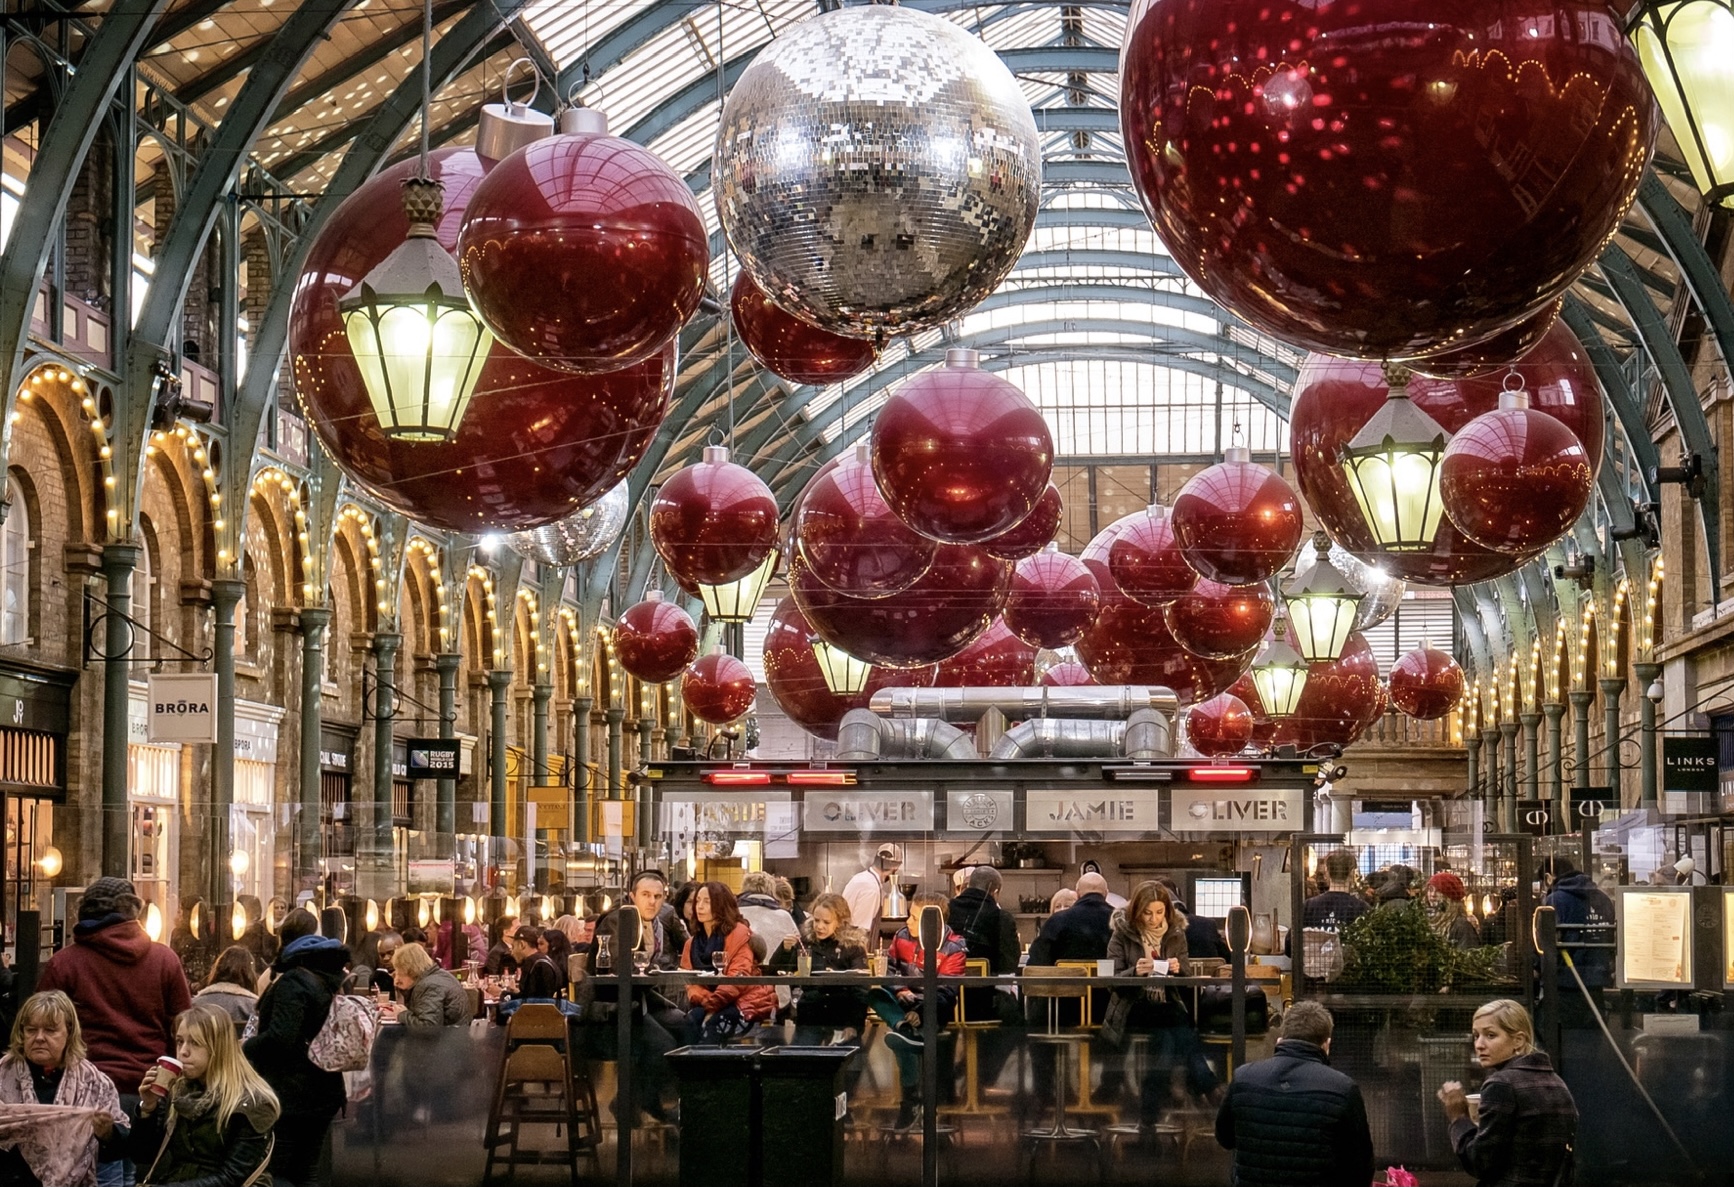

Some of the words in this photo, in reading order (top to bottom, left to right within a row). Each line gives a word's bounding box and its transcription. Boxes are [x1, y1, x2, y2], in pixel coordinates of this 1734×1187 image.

[132, 722, 148, 736] BROR
[430, 750, 455, 758] RUGBY
[429, 761, 454, 769] 2015
[1666, 757, 1715, 766] LINKS
[823, 801, 916, 822] OLIVER
[1049, 800, 1134, 821] JAMIE
[1188, 800, 1288, 821] OLIVER
